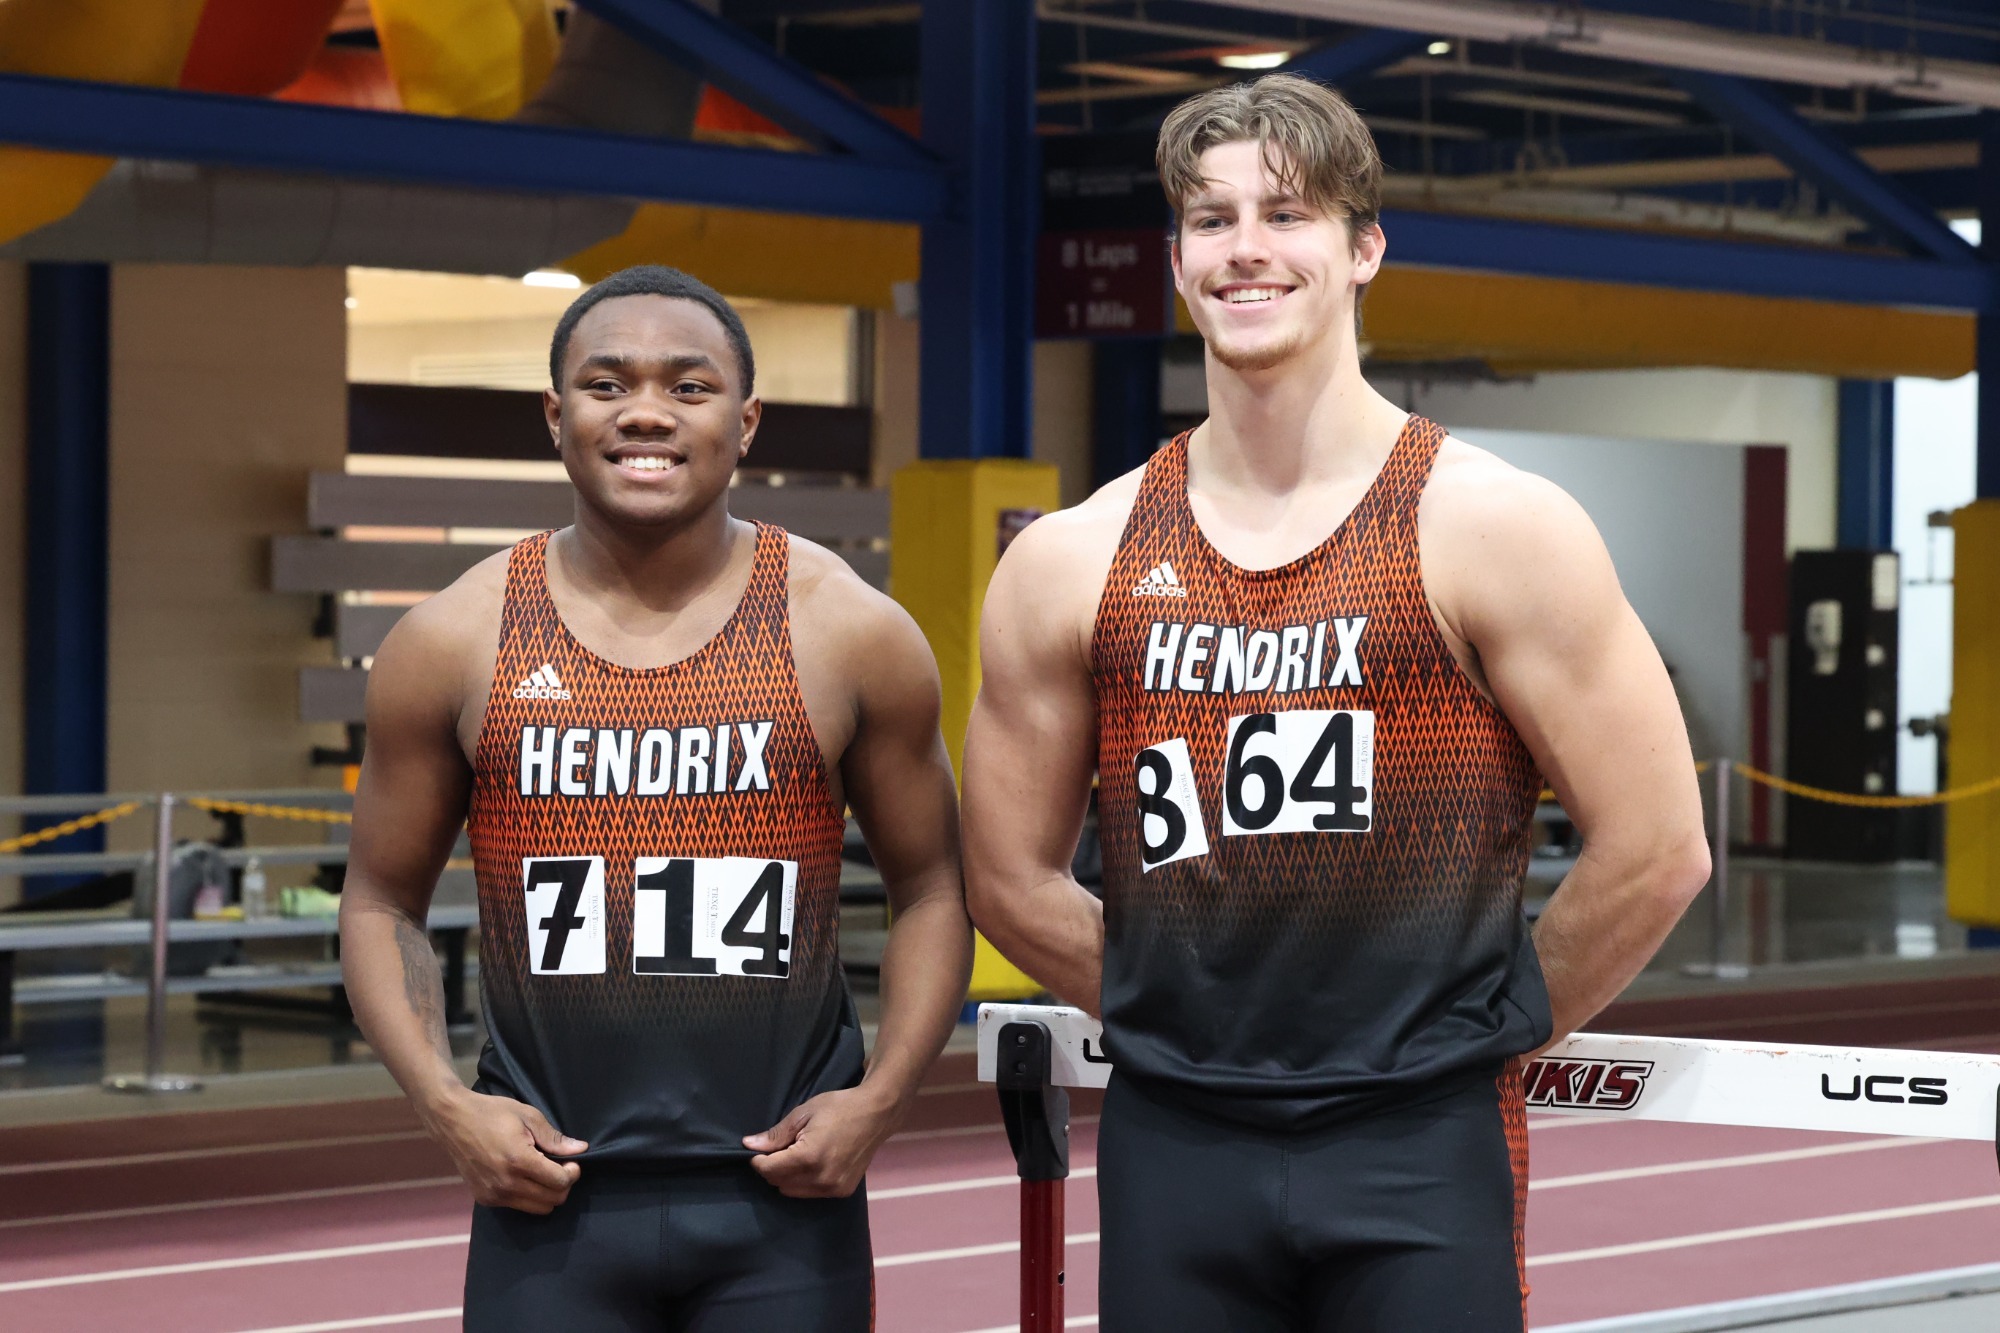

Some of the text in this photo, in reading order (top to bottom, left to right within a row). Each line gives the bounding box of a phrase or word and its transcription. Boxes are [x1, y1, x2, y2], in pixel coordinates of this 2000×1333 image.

[1132, 583, 1187, 597] adidas
[1144, 616, 1369, 694] HENDRIX
[512, 686, 571, 700] adidas
[520, 721, 774, 796] HENDRIX
[1135, 712, 1370, 865] 8 64
[526, 859, 592, 970] 7
[1821, 1073, 1948, 1105] UCS
